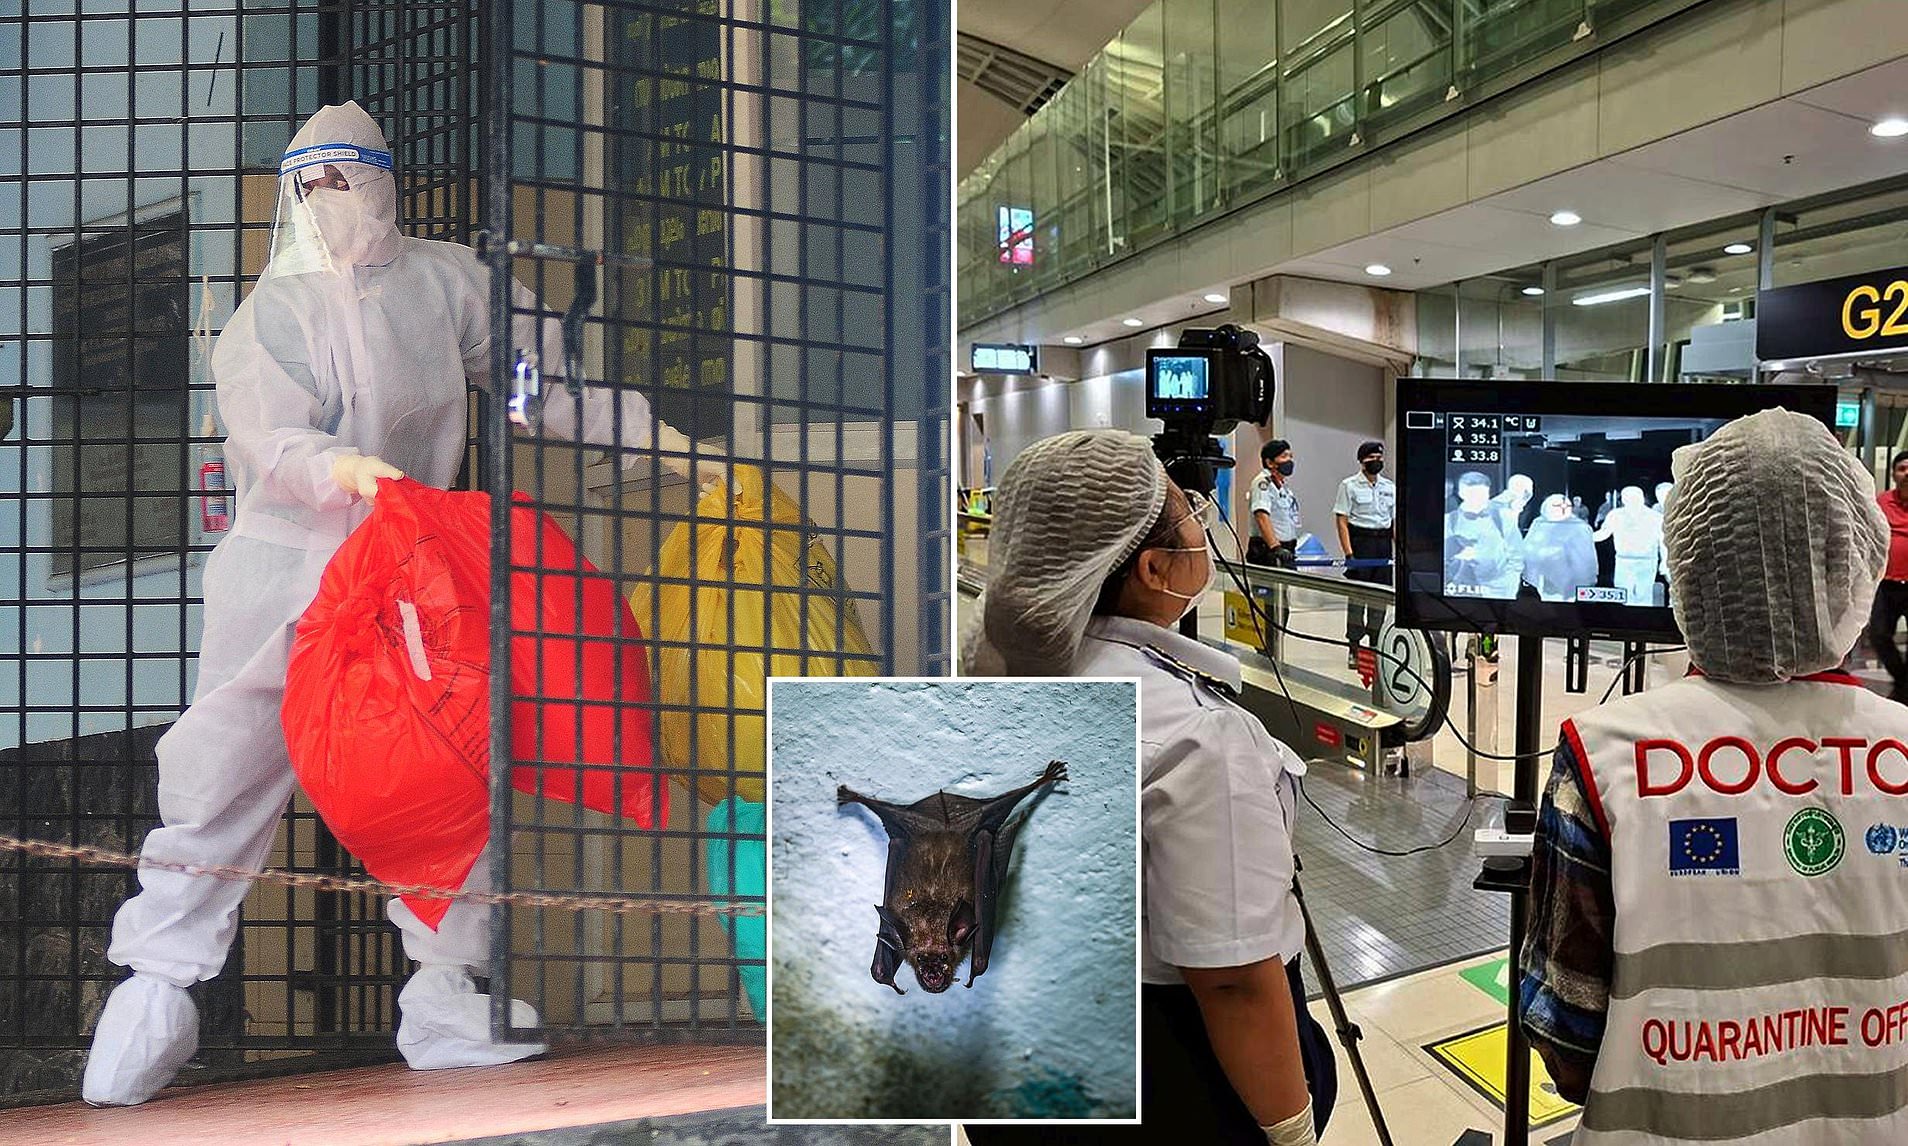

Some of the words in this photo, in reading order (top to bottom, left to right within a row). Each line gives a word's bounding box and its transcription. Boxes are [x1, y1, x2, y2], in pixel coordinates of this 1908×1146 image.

[293, 151, 331, 163] PROTECTOR
[1842, 280, 1908, 340] G2
[1471, 418, 1498, 429] 34.1
[1471, 433, 1498, 444] 35.1
[1470, 451, 1498, 461] 33.8
[1391, 634, 1411, 694] 2
[1635, 736, 1908, 798] DOCTO
[1641, 1007, 1850, 1066] QUARANTINE
[1860, 1000, 1908, 1048] OFF
